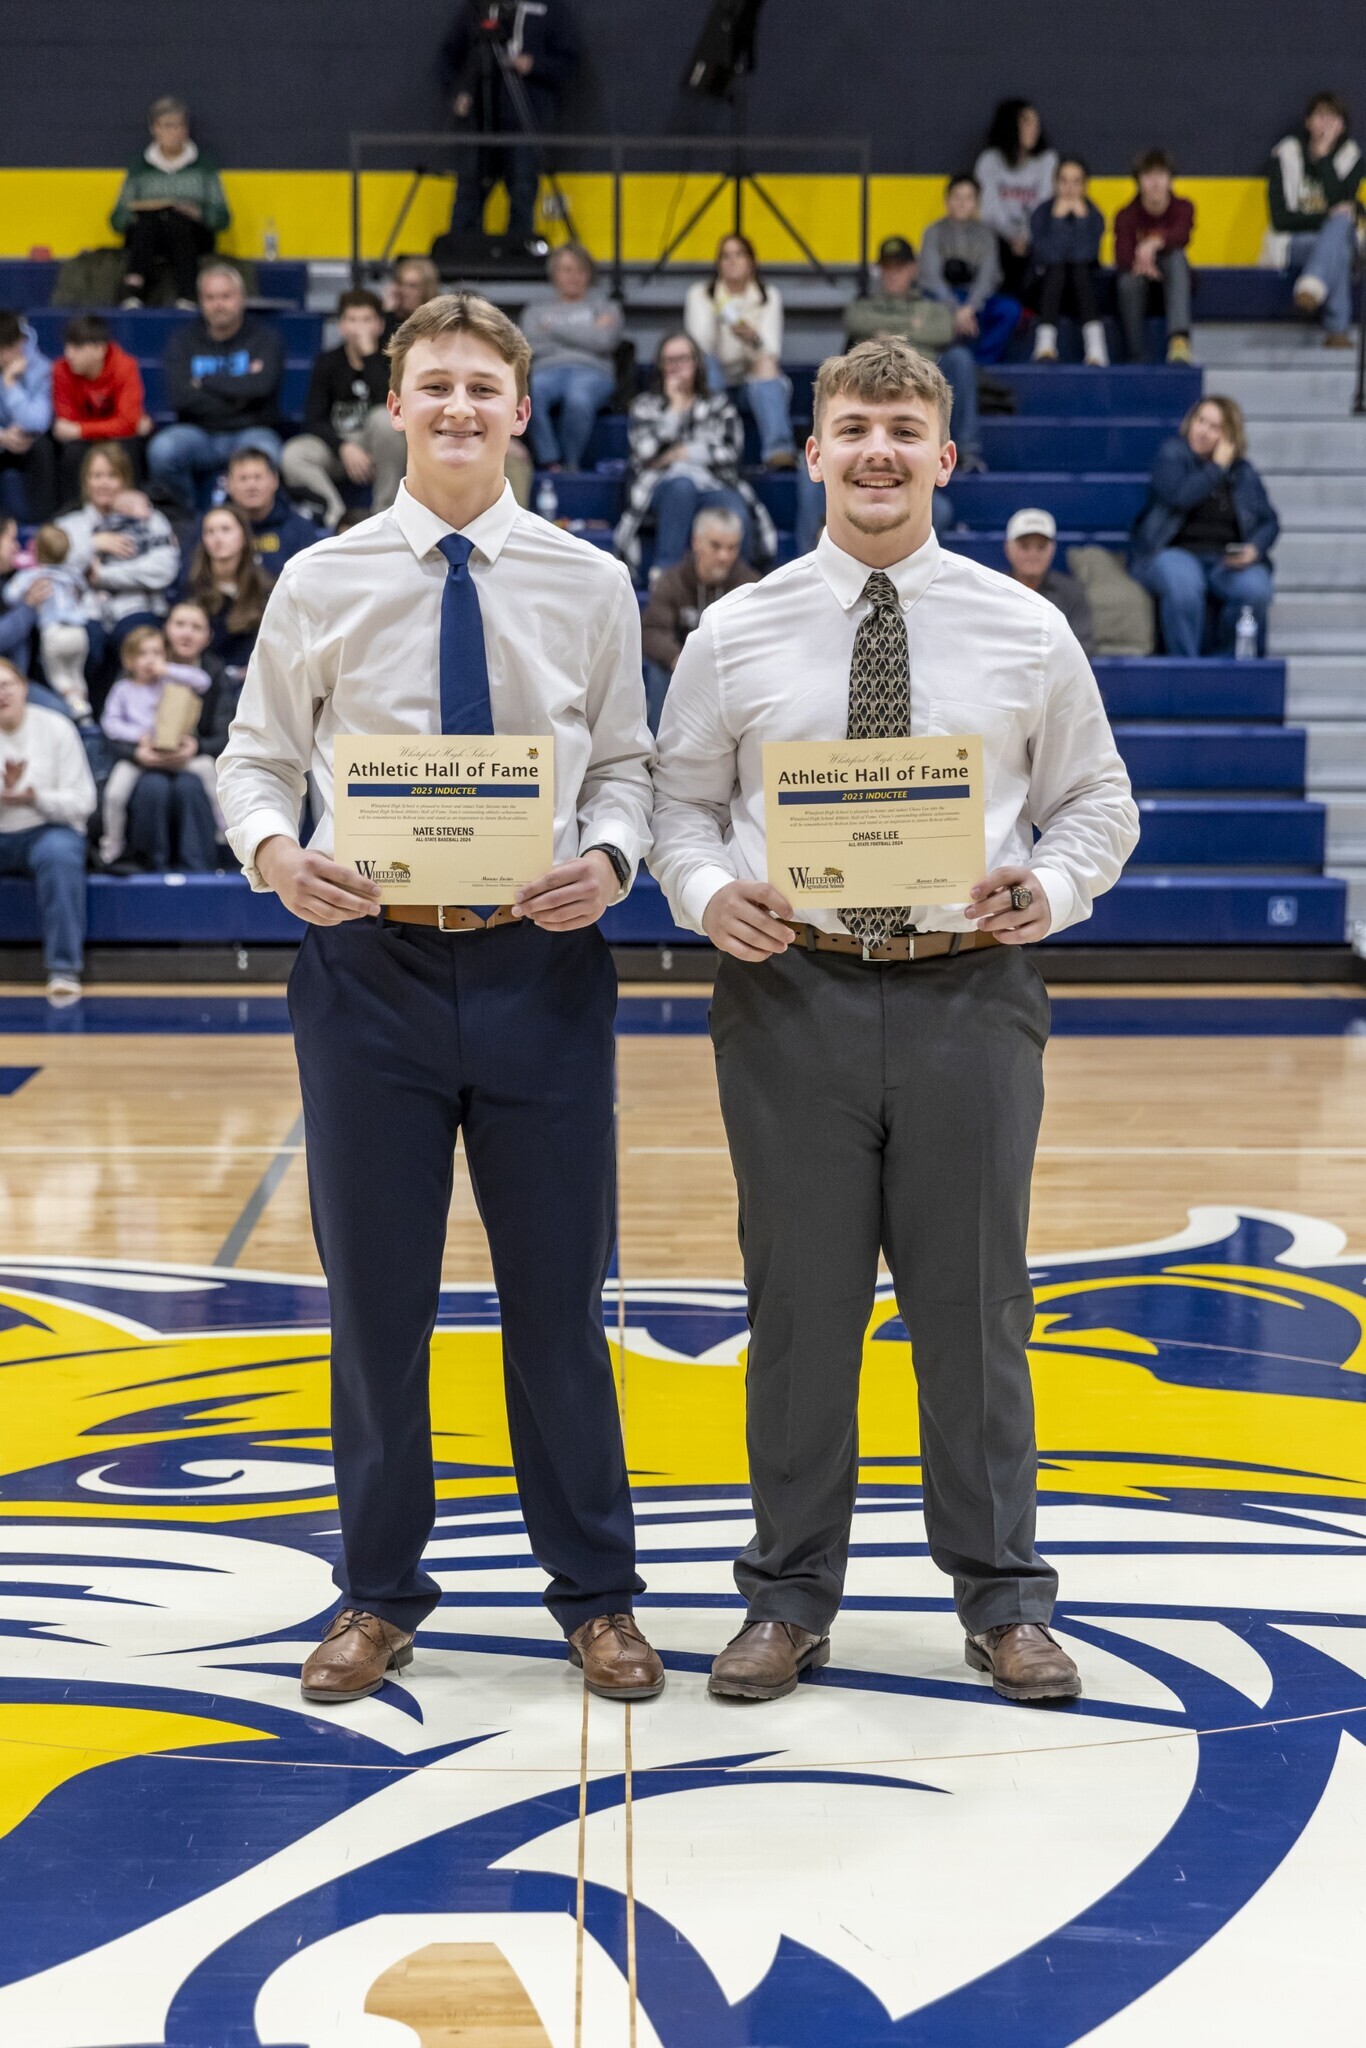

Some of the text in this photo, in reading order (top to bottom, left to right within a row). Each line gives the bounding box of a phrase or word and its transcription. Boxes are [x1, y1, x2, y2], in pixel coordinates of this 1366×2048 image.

[399, 746, 500, 761] Whiteford High School
[829, 750, 929, 767] Whiteford High School
[348, 761, 539, 777] Athletic Hall of Fame
[778, 765, 969, 785] Athletic Hall of Fame
[410, 787, 477, 795] 2025 INDUCTEE
[842, 791, 908, 801] 2025 INDUCTEE
[412, 827, 475, 836] NATE STEVENS
[852, 830, 899, 841] CHASE LEE
[788, 866, 845, 890] WHITEFORD
